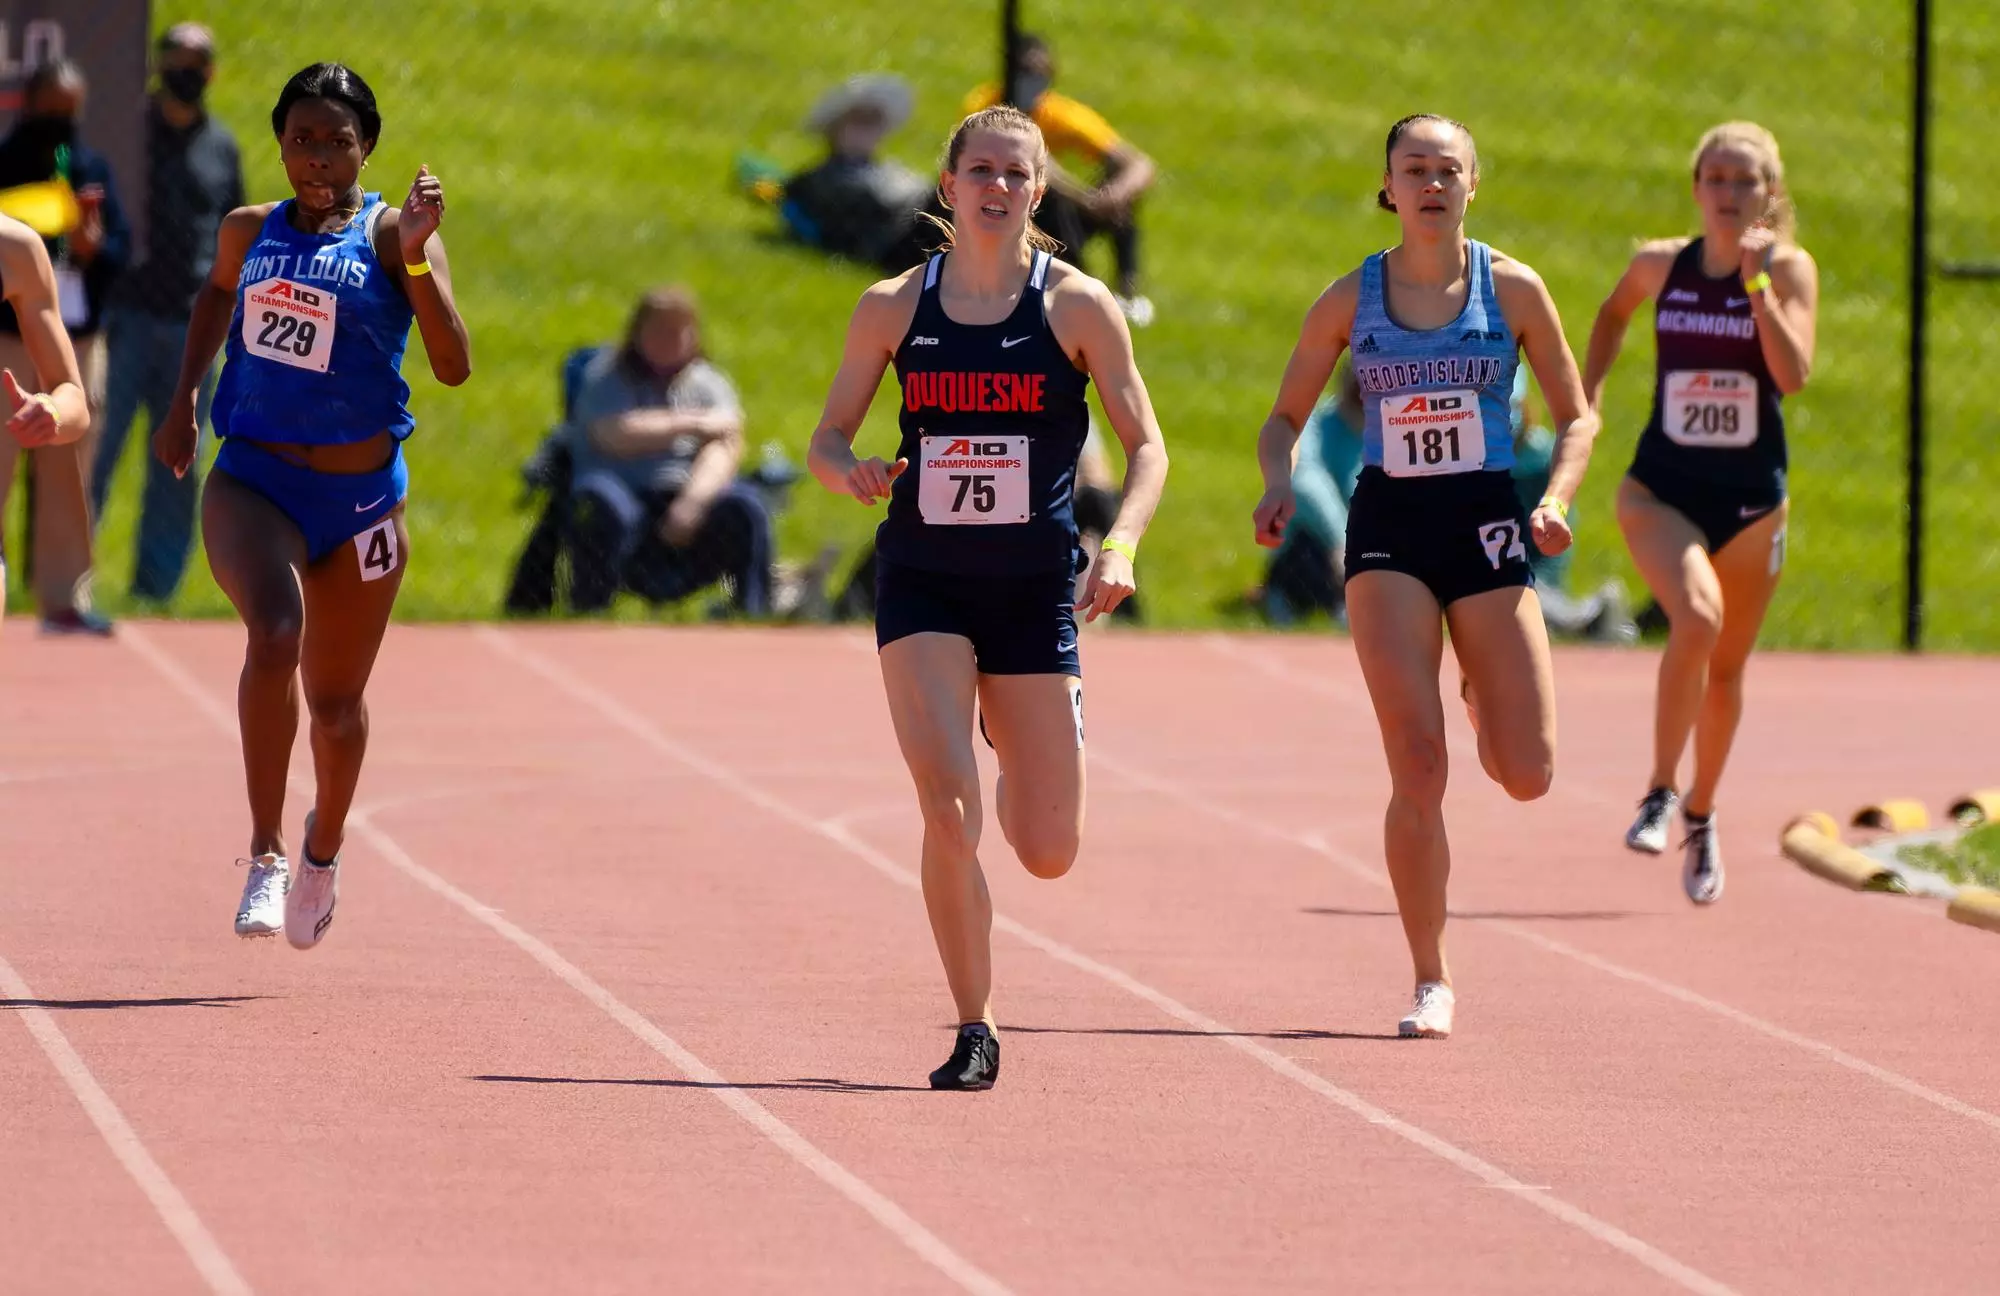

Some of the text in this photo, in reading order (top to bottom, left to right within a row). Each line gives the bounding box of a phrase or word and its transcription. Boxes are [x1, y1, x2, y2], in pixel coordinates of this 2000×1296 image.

[293, 255, 367, 289] LOUIS
[251, 294, 329, 321] CHAMPIONSHIPS
[266, 281, 320, 306] A10
[256, 311, 317, 357] 229
[1460, 330, 1504, 342] A10
[1658, 310, 1755, 339] RICHMOND
[910, 336, 939, 346] A10
[1359, 357, 1501, 393] RHODE ISLAND
[906, 372, 1047, 412] DUQUESNE
[1401, 396, 1461, 413] A10
[1388, 410, 1475, 426] CHAMPIONSHIPS
[1682, 403, 1740, 435] 209
[941, 439, 1008, 456] A10
[1403, 427, 1460, 465] 181
[927, 459, 1021, 469] CHAMPIONSHIPS
[949, 475, 995, 513] 75
[364, 527, 392, 572] 4
[1486, 525, 1521, 571] 2
